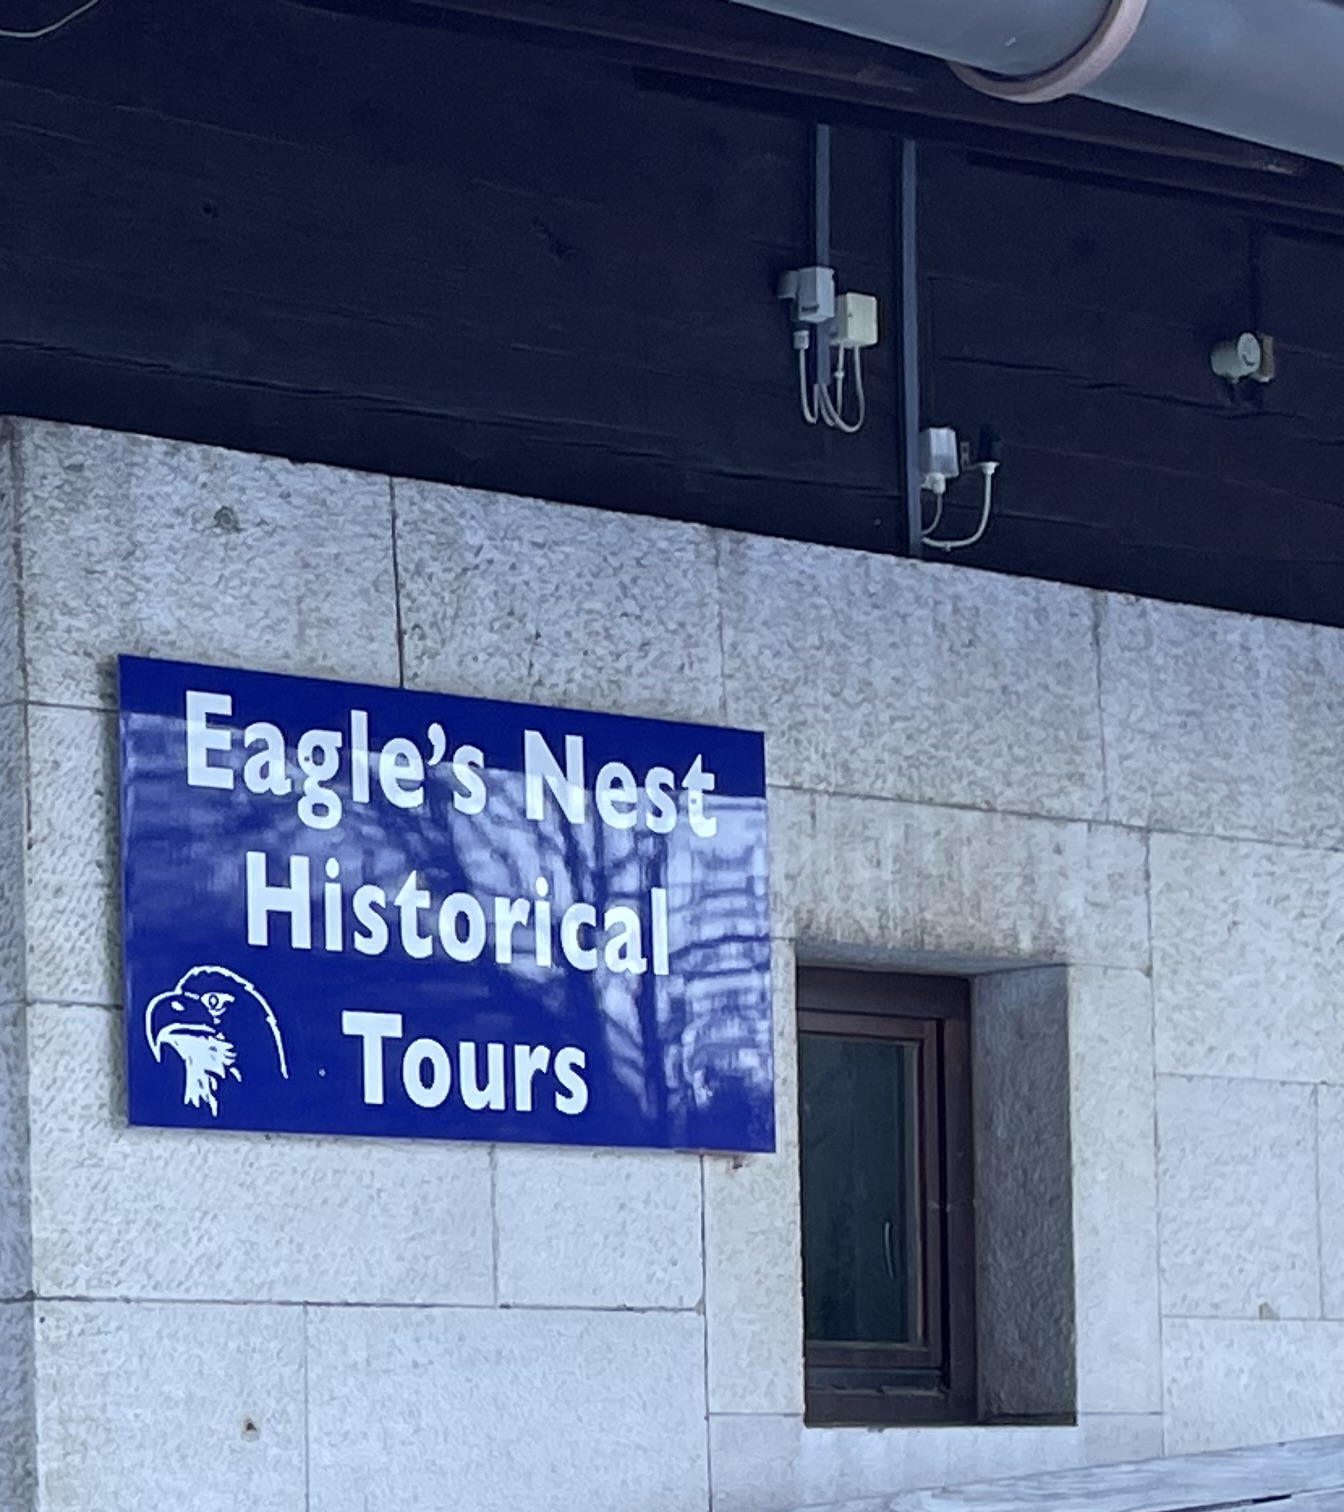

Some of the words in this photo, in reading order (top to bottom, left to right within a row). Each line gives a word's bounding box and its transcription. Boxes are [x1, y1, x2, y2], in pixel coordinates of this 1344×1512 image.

[185, 690, 487, 830] Eagle's
[524, 729, 717, 838] Nest
[246, 851, 670, 976] Historical
[341, 1010, 589, 1115] Tours
